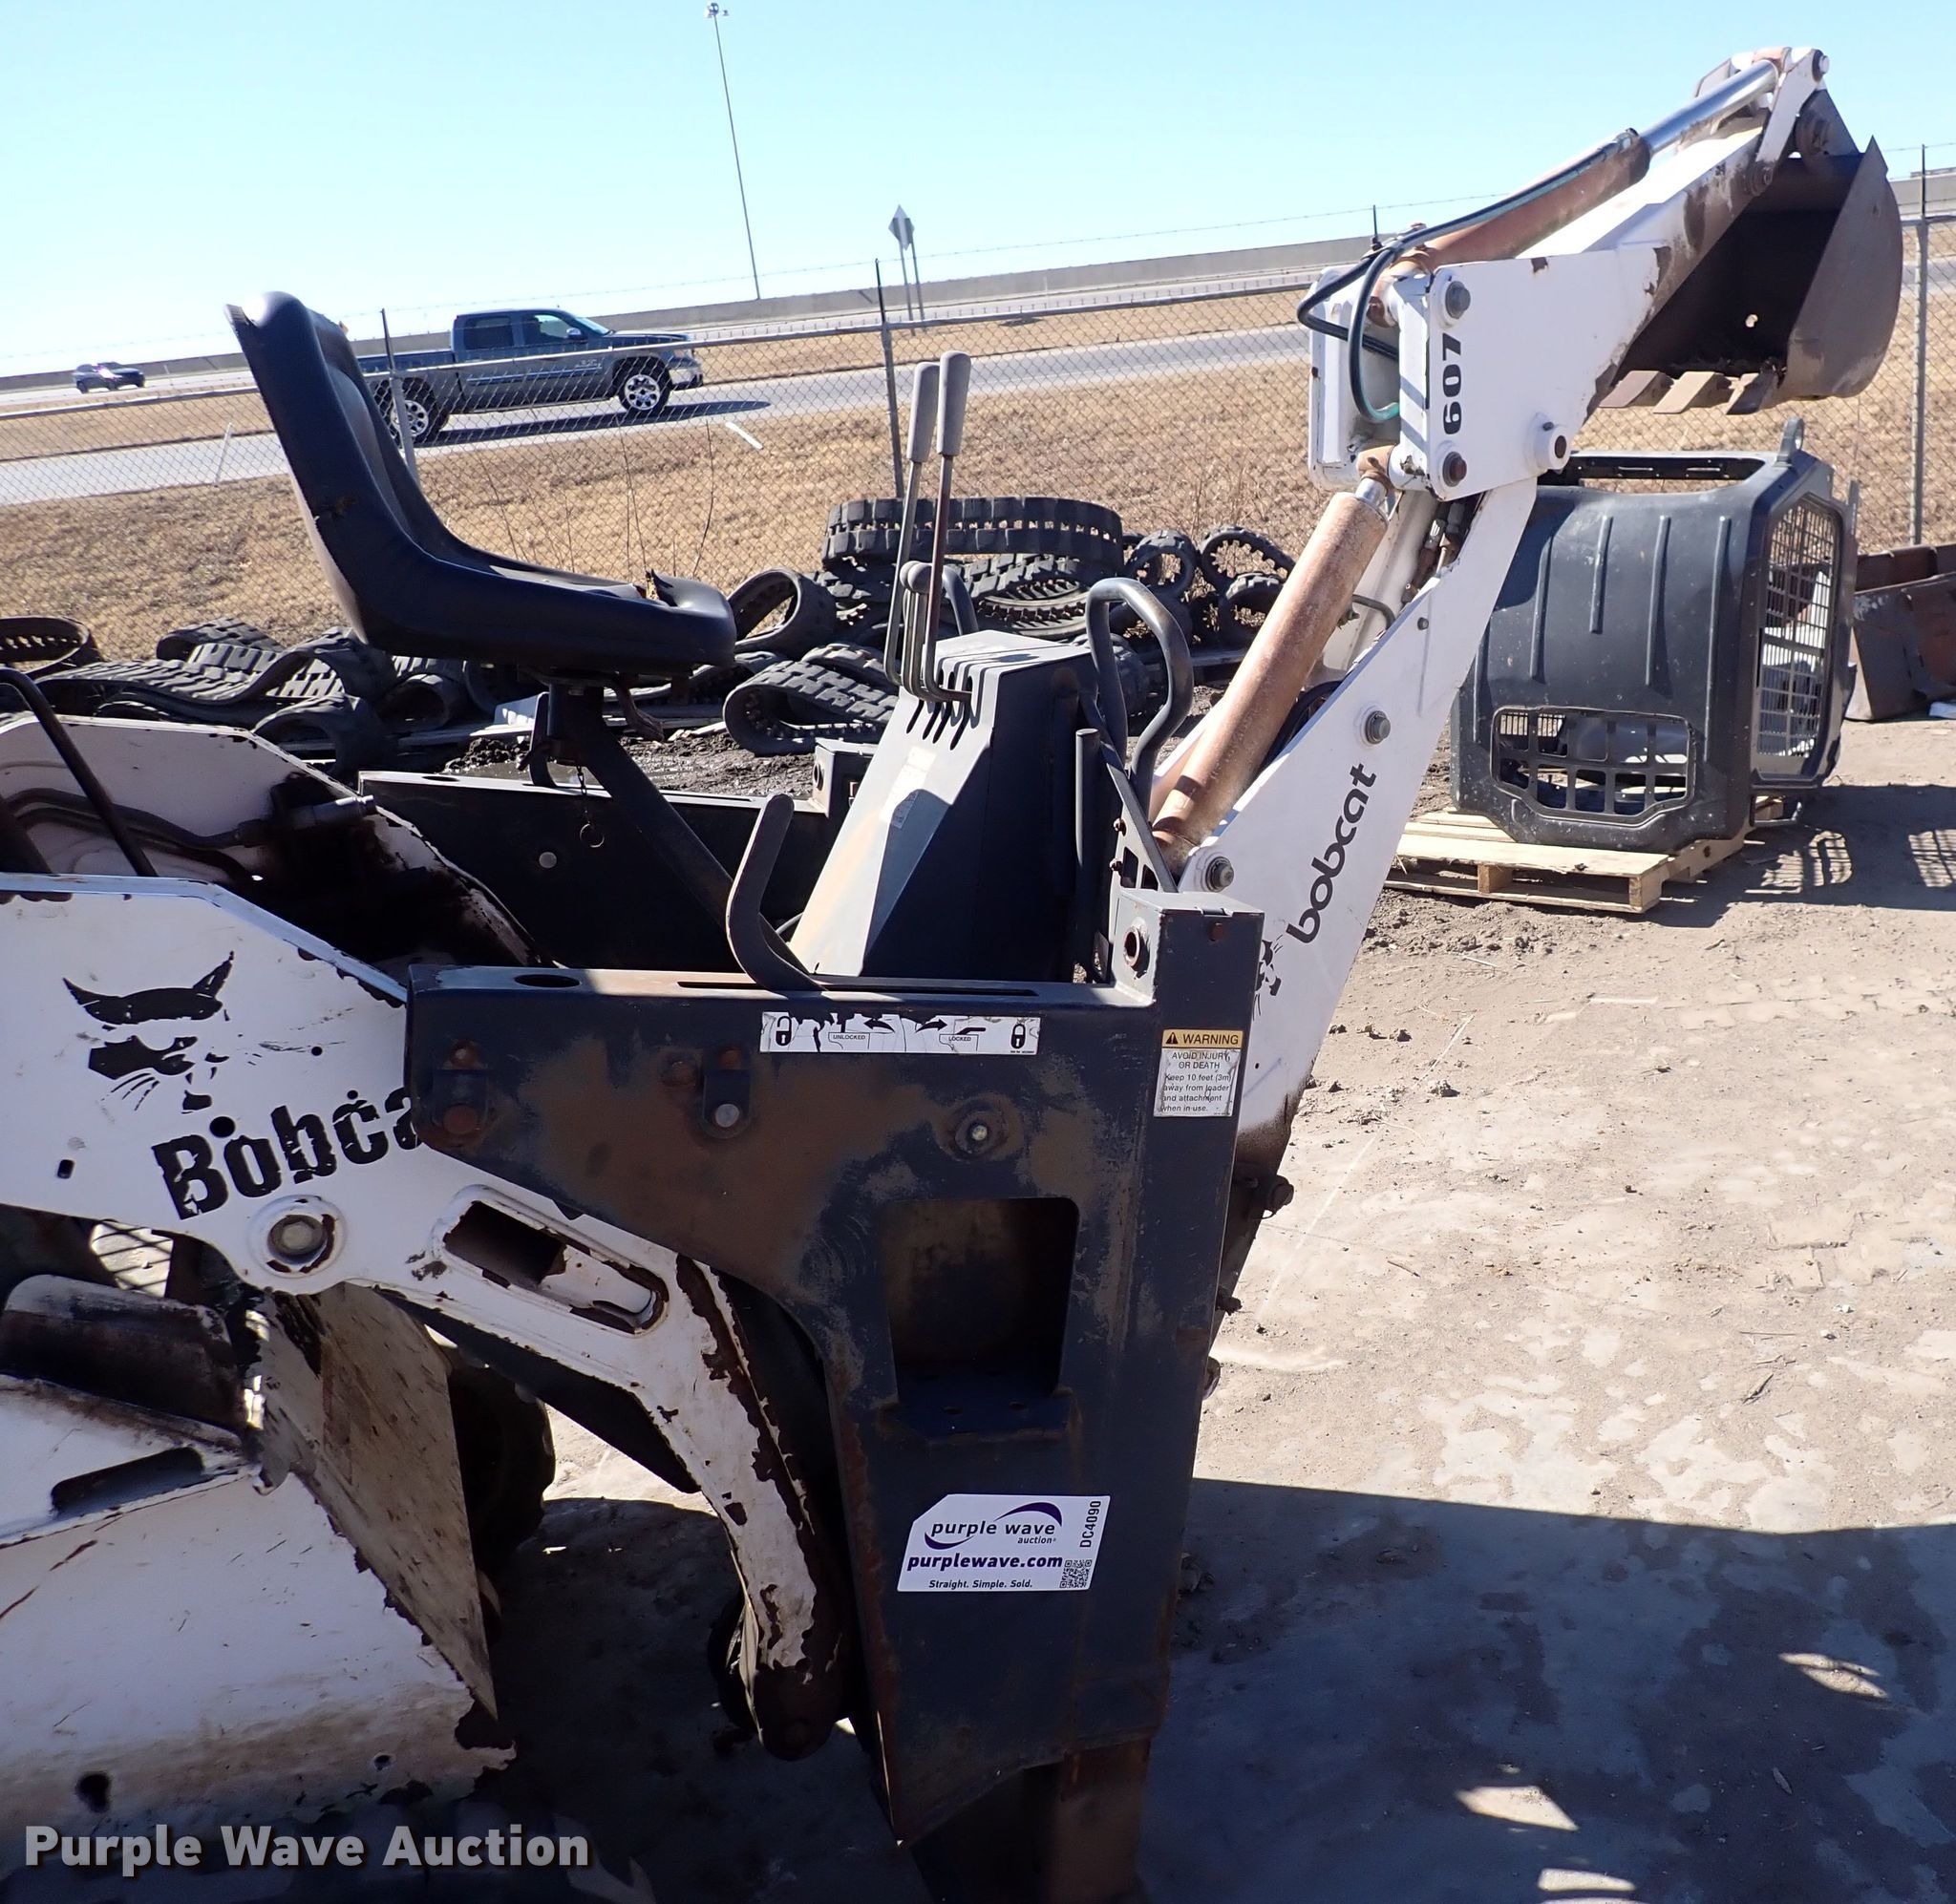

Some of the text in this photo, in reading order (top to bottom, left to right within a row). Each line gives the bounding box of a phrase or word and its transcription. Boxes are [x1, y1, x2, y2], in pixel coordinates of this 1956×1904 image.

[1442, 332, 1461, 434] 607
[1286, 763, 1377, 943] bobcat
[1182, 1033, 1239, 1045] WARNING
[1172, 1051, 1198, 1060] AVOID
[1165, 1073, 1184, 1082] Keep
[1215, 1073, 1232, 1082] (3m)
[151, 1087, 423, 1220] Bobca
[930, 1520, 1055, 1537] purple wave
[1079, 1500, 1102, 1548] DC4090
[907, 1553, 1063, 1572] purplewave.com
[928, 1579, 1033, 1590] Straight. Simple. Sold.
